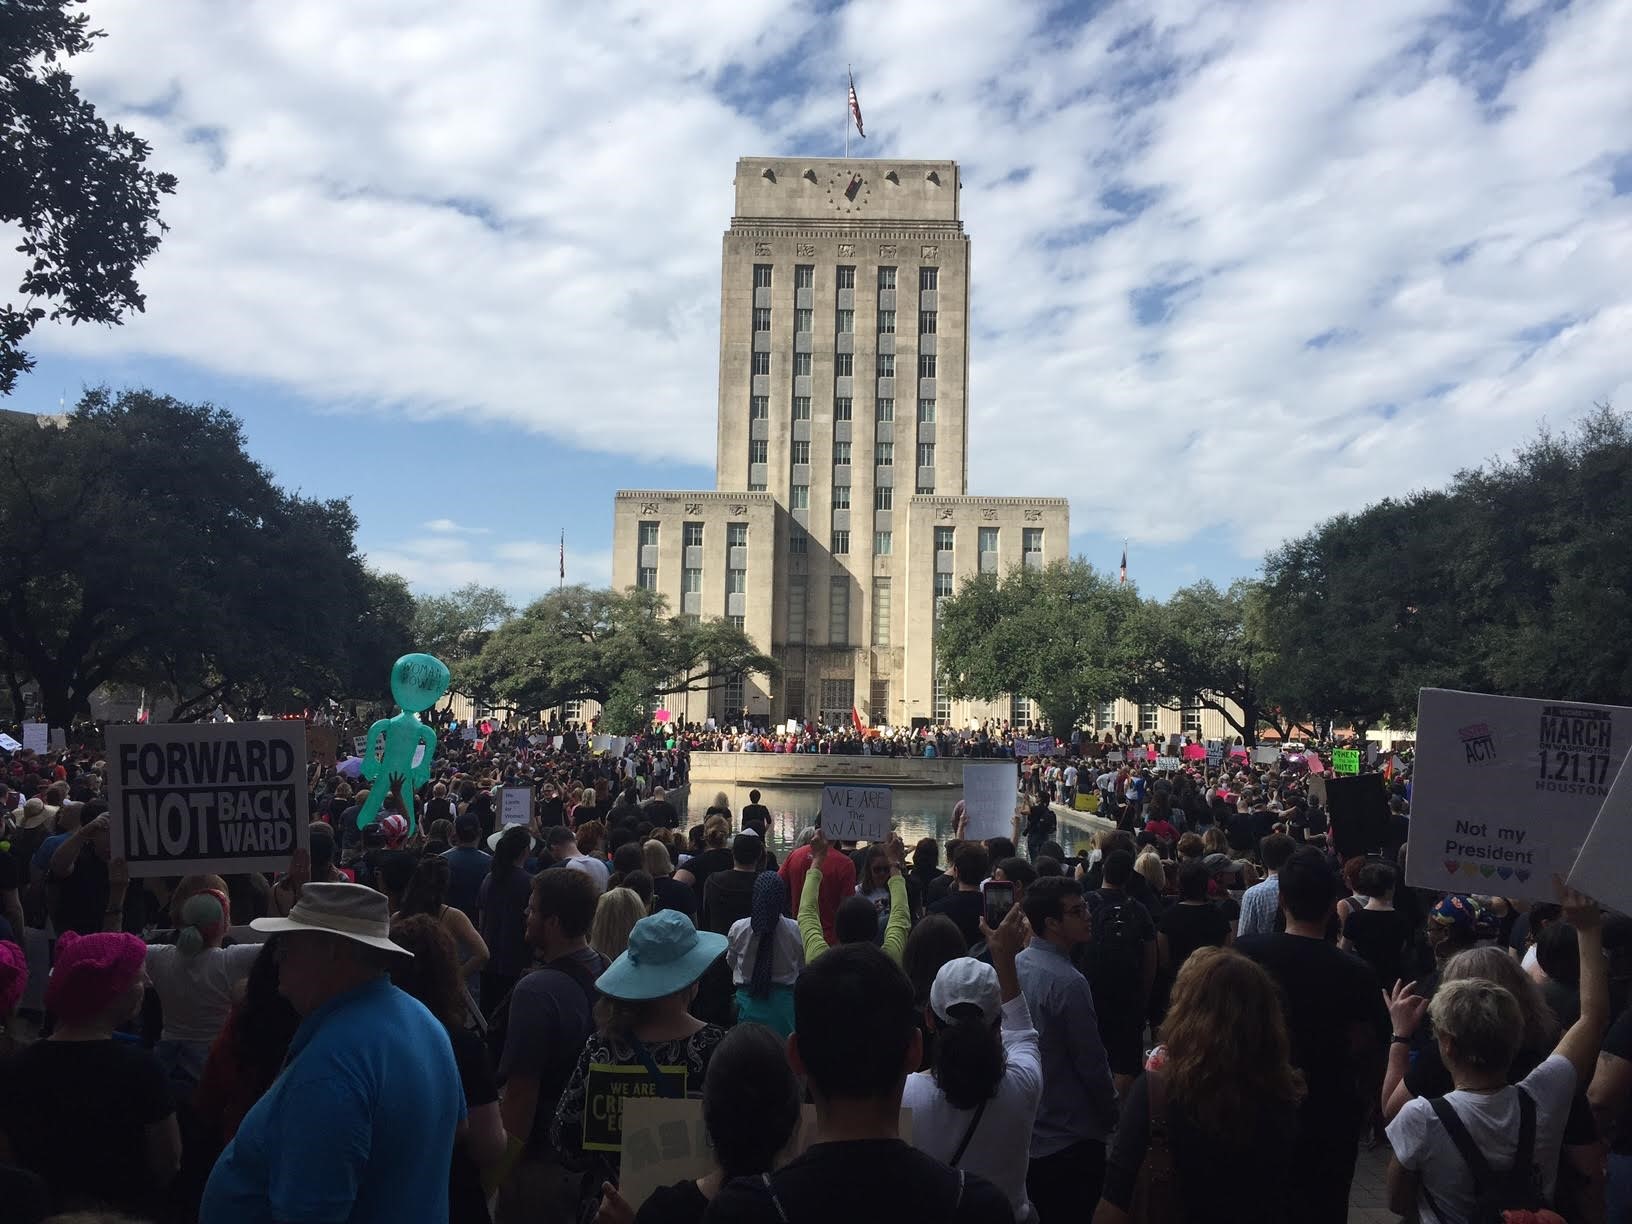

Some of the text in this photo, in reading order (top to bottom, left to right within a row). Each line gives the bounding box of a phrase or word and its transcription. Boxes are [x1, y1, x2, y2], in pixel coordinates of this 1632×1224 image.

[1540, 716, 1611, 748] MARCH
[120, 738, 295, 786] FORWARD
[1465, 736, 1497, 763] ACT!
[1538, 750, 1610, 784] 1.21.17
[826, 787, 889, 809] WE ARE
[1536, 781, 1608, 797] HOUSTON
[218, 789, 292, 822] BACK
[128, 791, 215, 856] NOT
[220, 821, 293, 853] WARD
[827, 821, 882, 838] WALL!
[1456, 820, 1527, 845] Not my
[1445, 840, 1535, 865] President
[610, 1082, 657, 1096] WE ARE
